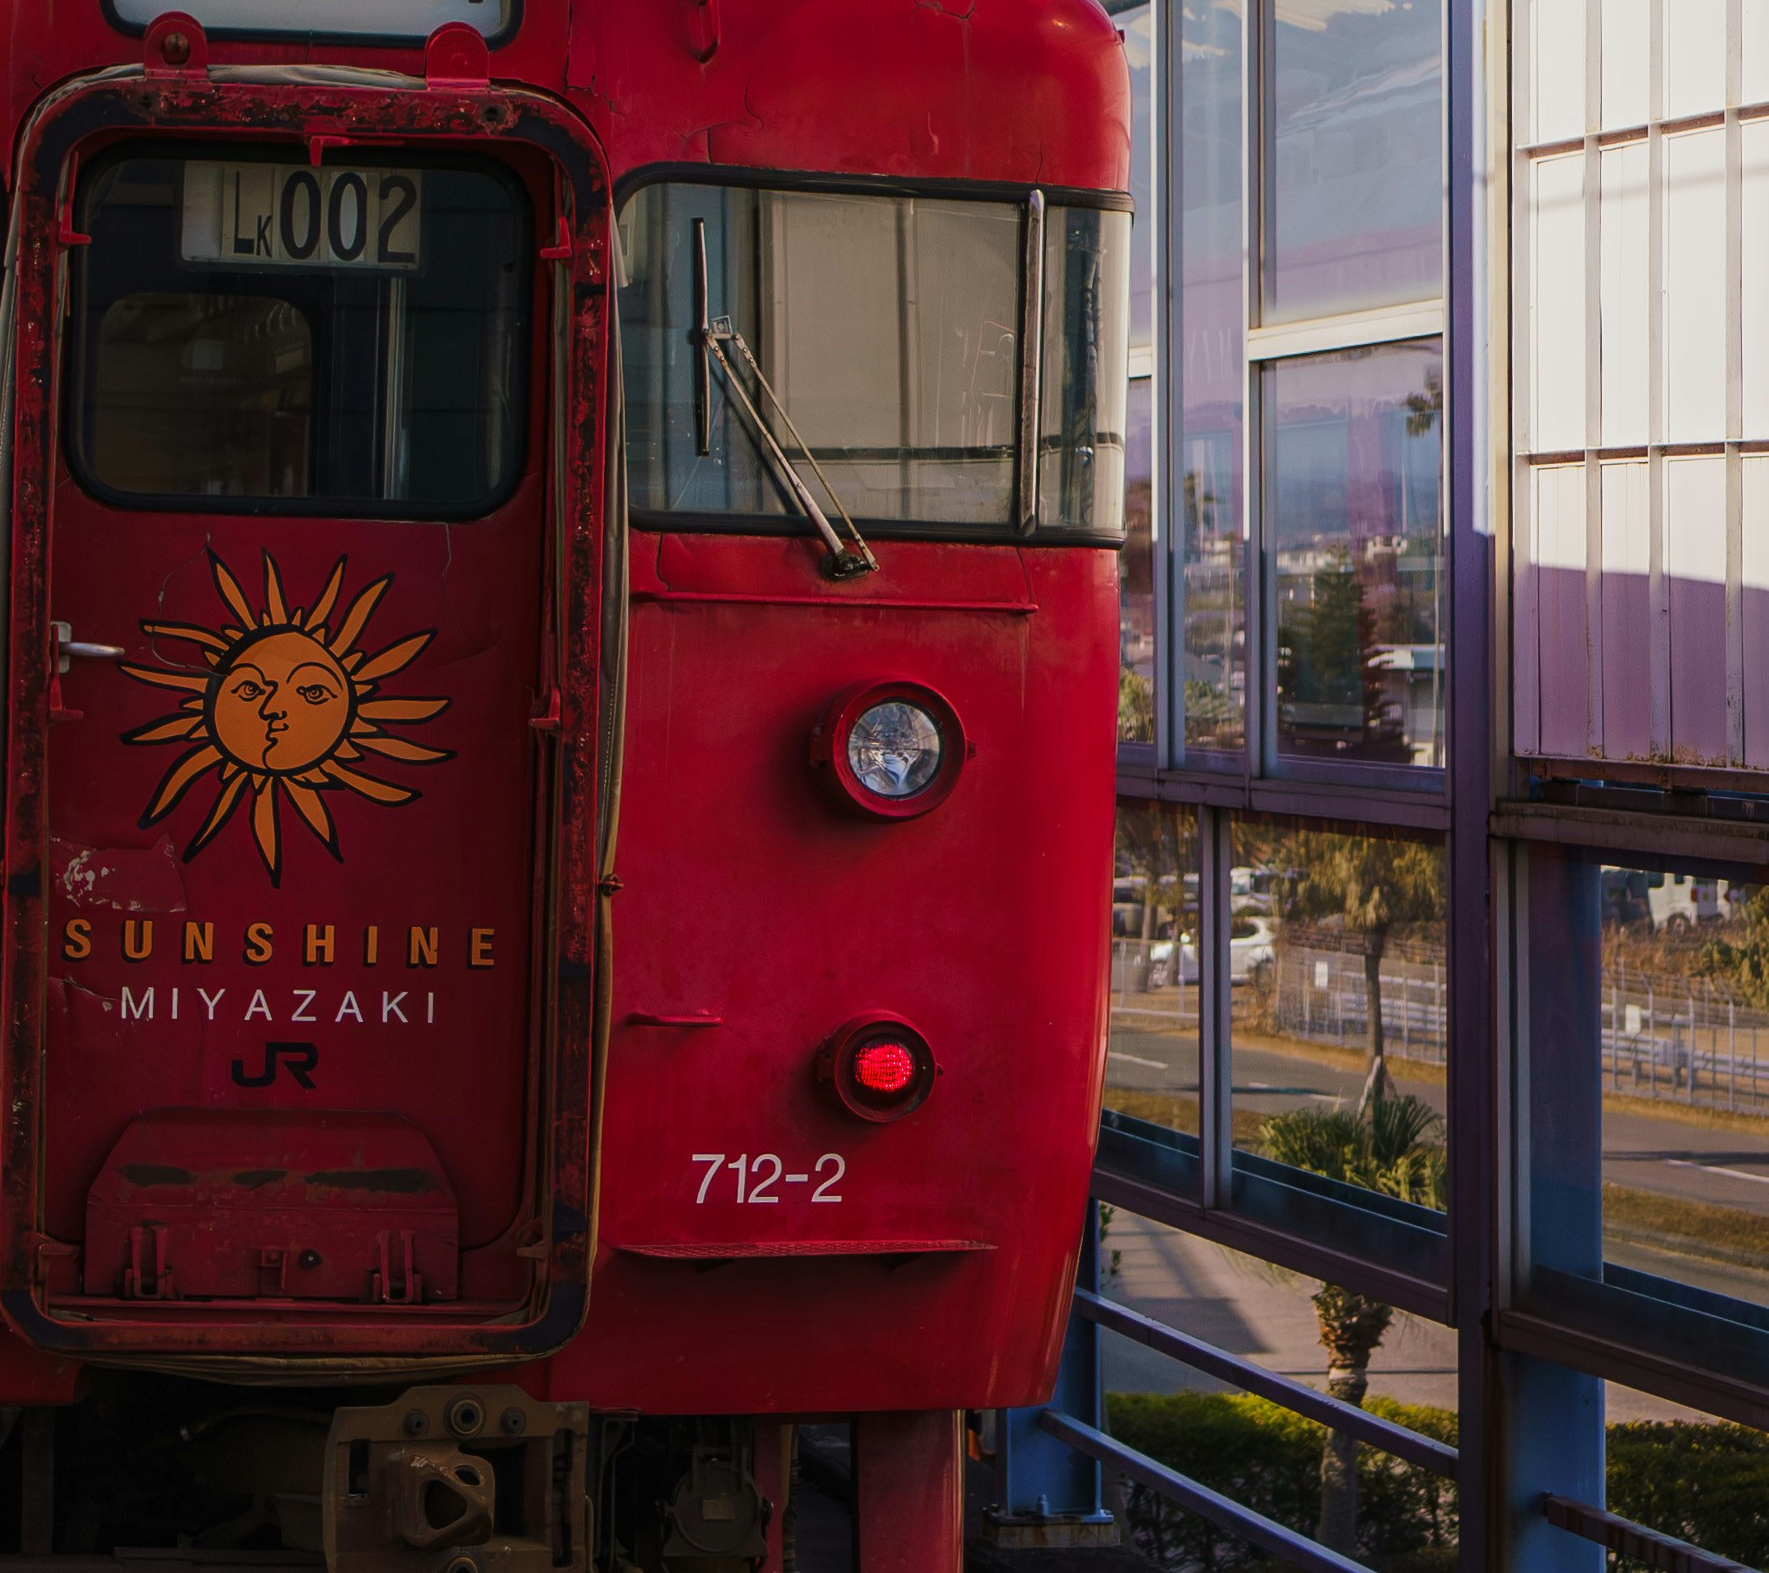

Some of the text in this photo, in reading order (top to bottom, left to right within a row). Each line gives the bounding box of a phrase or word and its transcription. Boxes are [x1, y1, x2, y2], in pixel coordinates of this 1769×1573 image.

[60, 918, 498, 969] SUNSHINE
[120, 985, 436, 1024] MIYAZAKI
[230, 1041, 319, 1090] JR
[691, 1153, 847, 1204] 712-2
